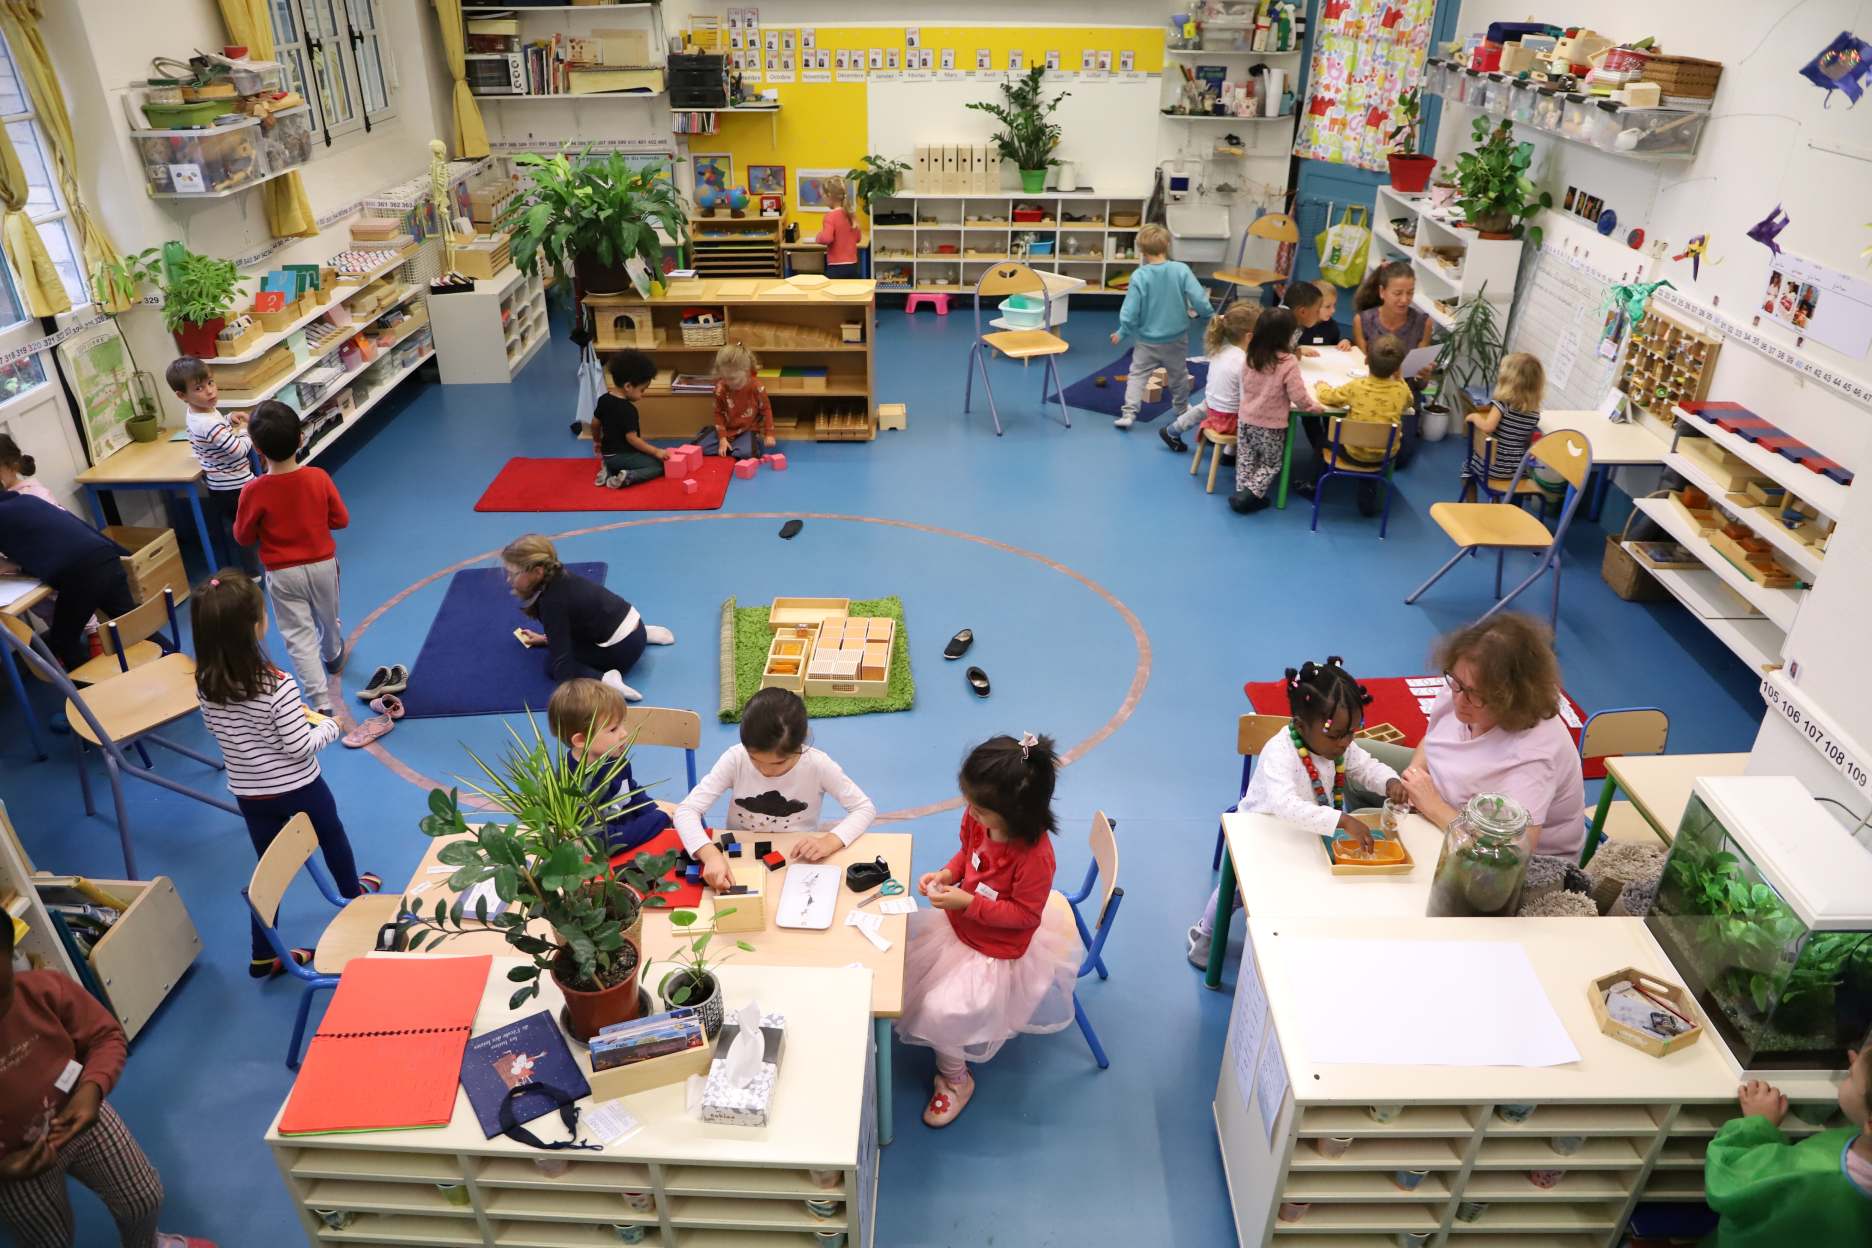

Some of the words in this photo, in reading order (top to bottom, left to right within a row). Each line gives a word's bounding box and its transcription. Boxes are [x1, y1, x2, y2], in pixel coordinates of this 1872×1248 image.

[143, 296, 160, 305] 329
[16, 347, 27, 357] 319
[28, 341, 42, 352] 320
[43, 336, 56, 348] 321
[1814, 368, 1822, 379] 42
[1823, 373, 1832, 383] 43
[1832, 377, 1842, 387] 44
[1842, 382, 1853, 392] 45
[1853, 387, 1862, 398] 46
[1863, 393, 1872, 402] 47
[1763, 681, 1780, 704] 105
[1782, 700, 1801, 724] 106
[1803, 720, 1824, 743] 107
[1824, 741, 1845, 766] 108
[1847, 762, 1867, 788] 109
